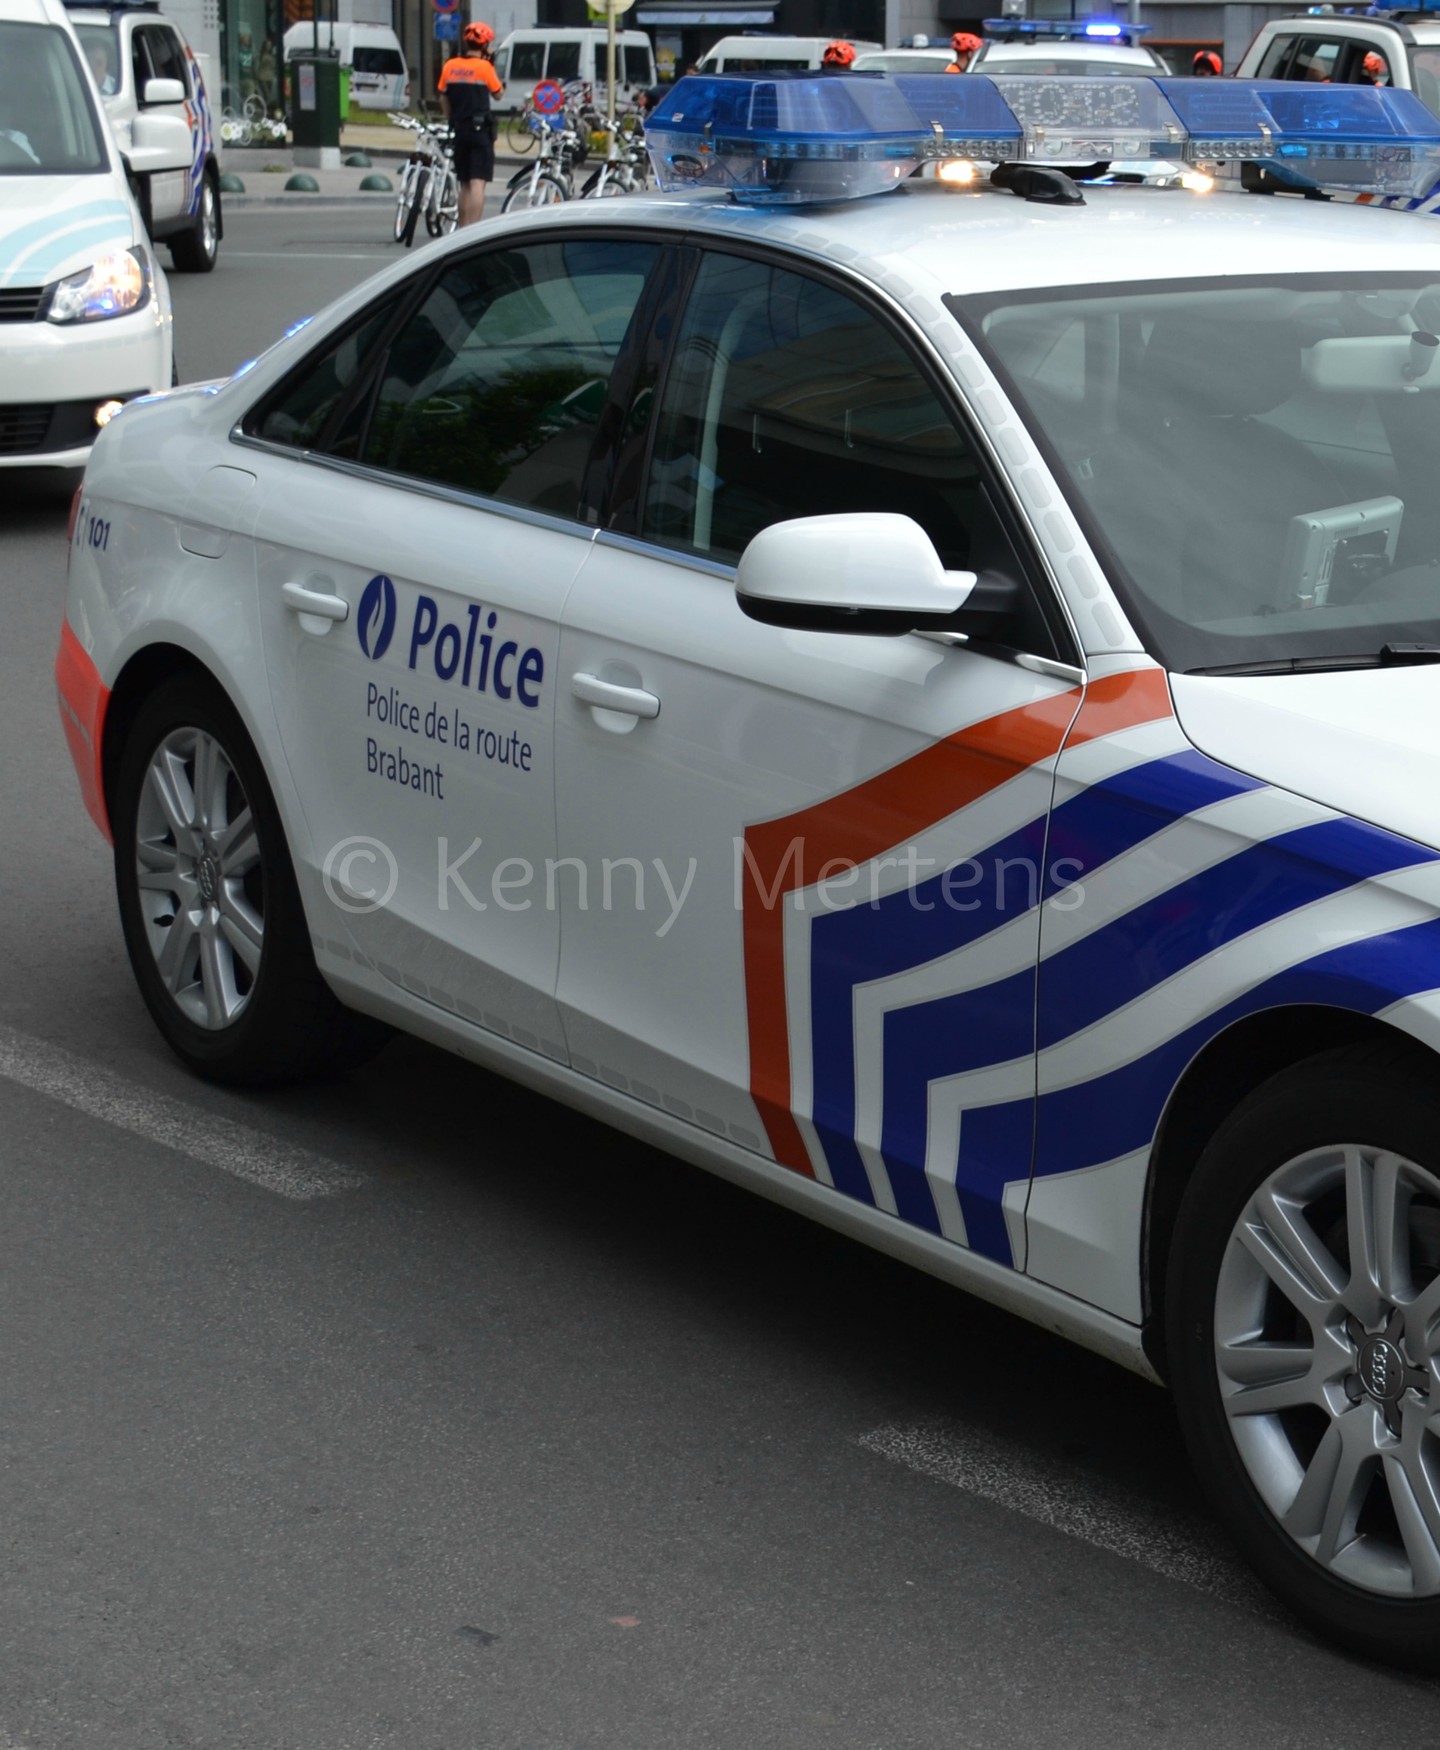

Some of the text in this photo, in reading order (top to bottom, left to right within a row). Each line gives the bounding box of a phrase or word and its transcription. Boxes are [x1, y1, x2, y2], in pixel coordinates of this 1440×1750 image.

[88, 516, 111, 551] 101
[408, 595, 545, 708] Police
[366, 683, 533, 773] Police de la route
[366, 738, 444, 800] Brabant
